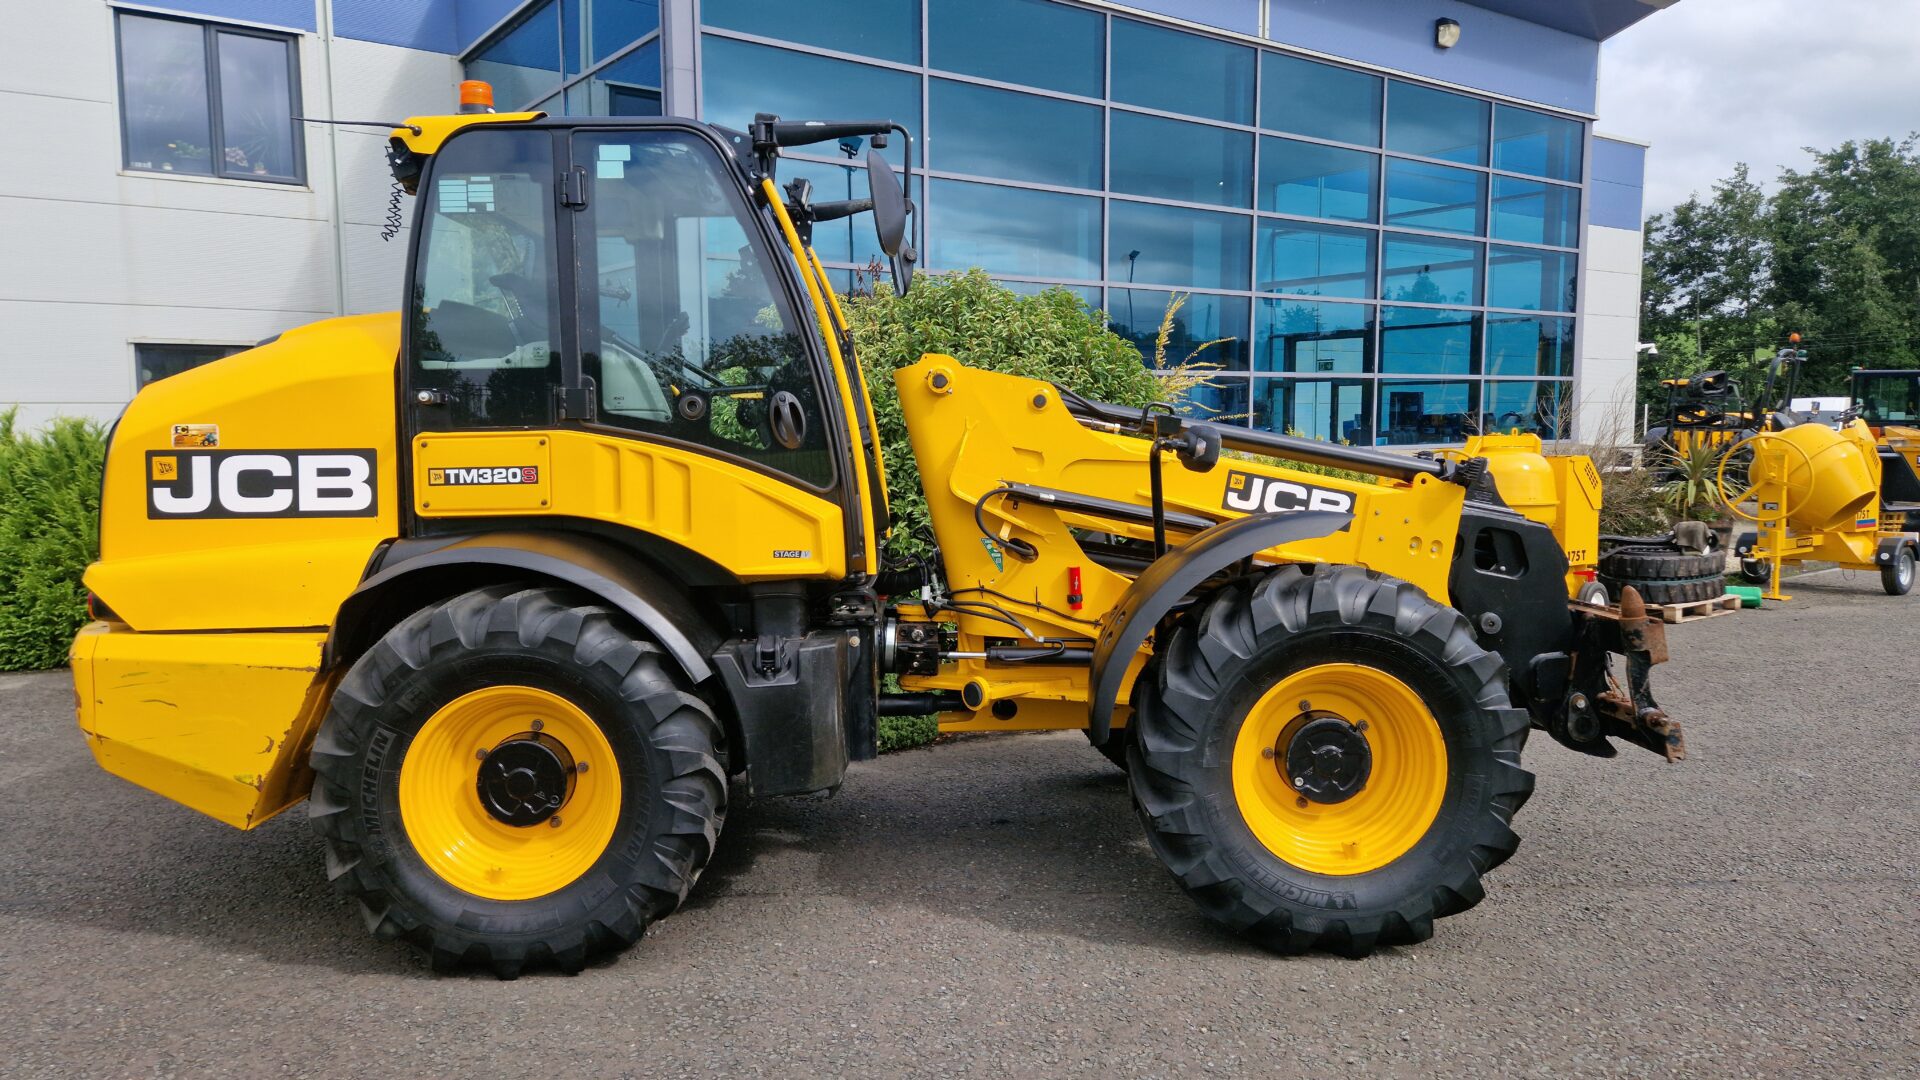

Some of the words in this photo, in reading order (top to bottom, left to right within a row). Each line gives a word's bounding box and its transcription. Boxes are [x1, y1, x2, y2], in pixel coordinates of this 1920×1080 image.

[152, 454, 372, 513] JCB
[158, 461, 174, 474] JCB
[445, 467, 537, 484] TM320S
[774, 550, 800, 558] STAGE
[363, 731, 389, 835] MICHELIN
[1235, 851, 1329, 908] MICHELIN
